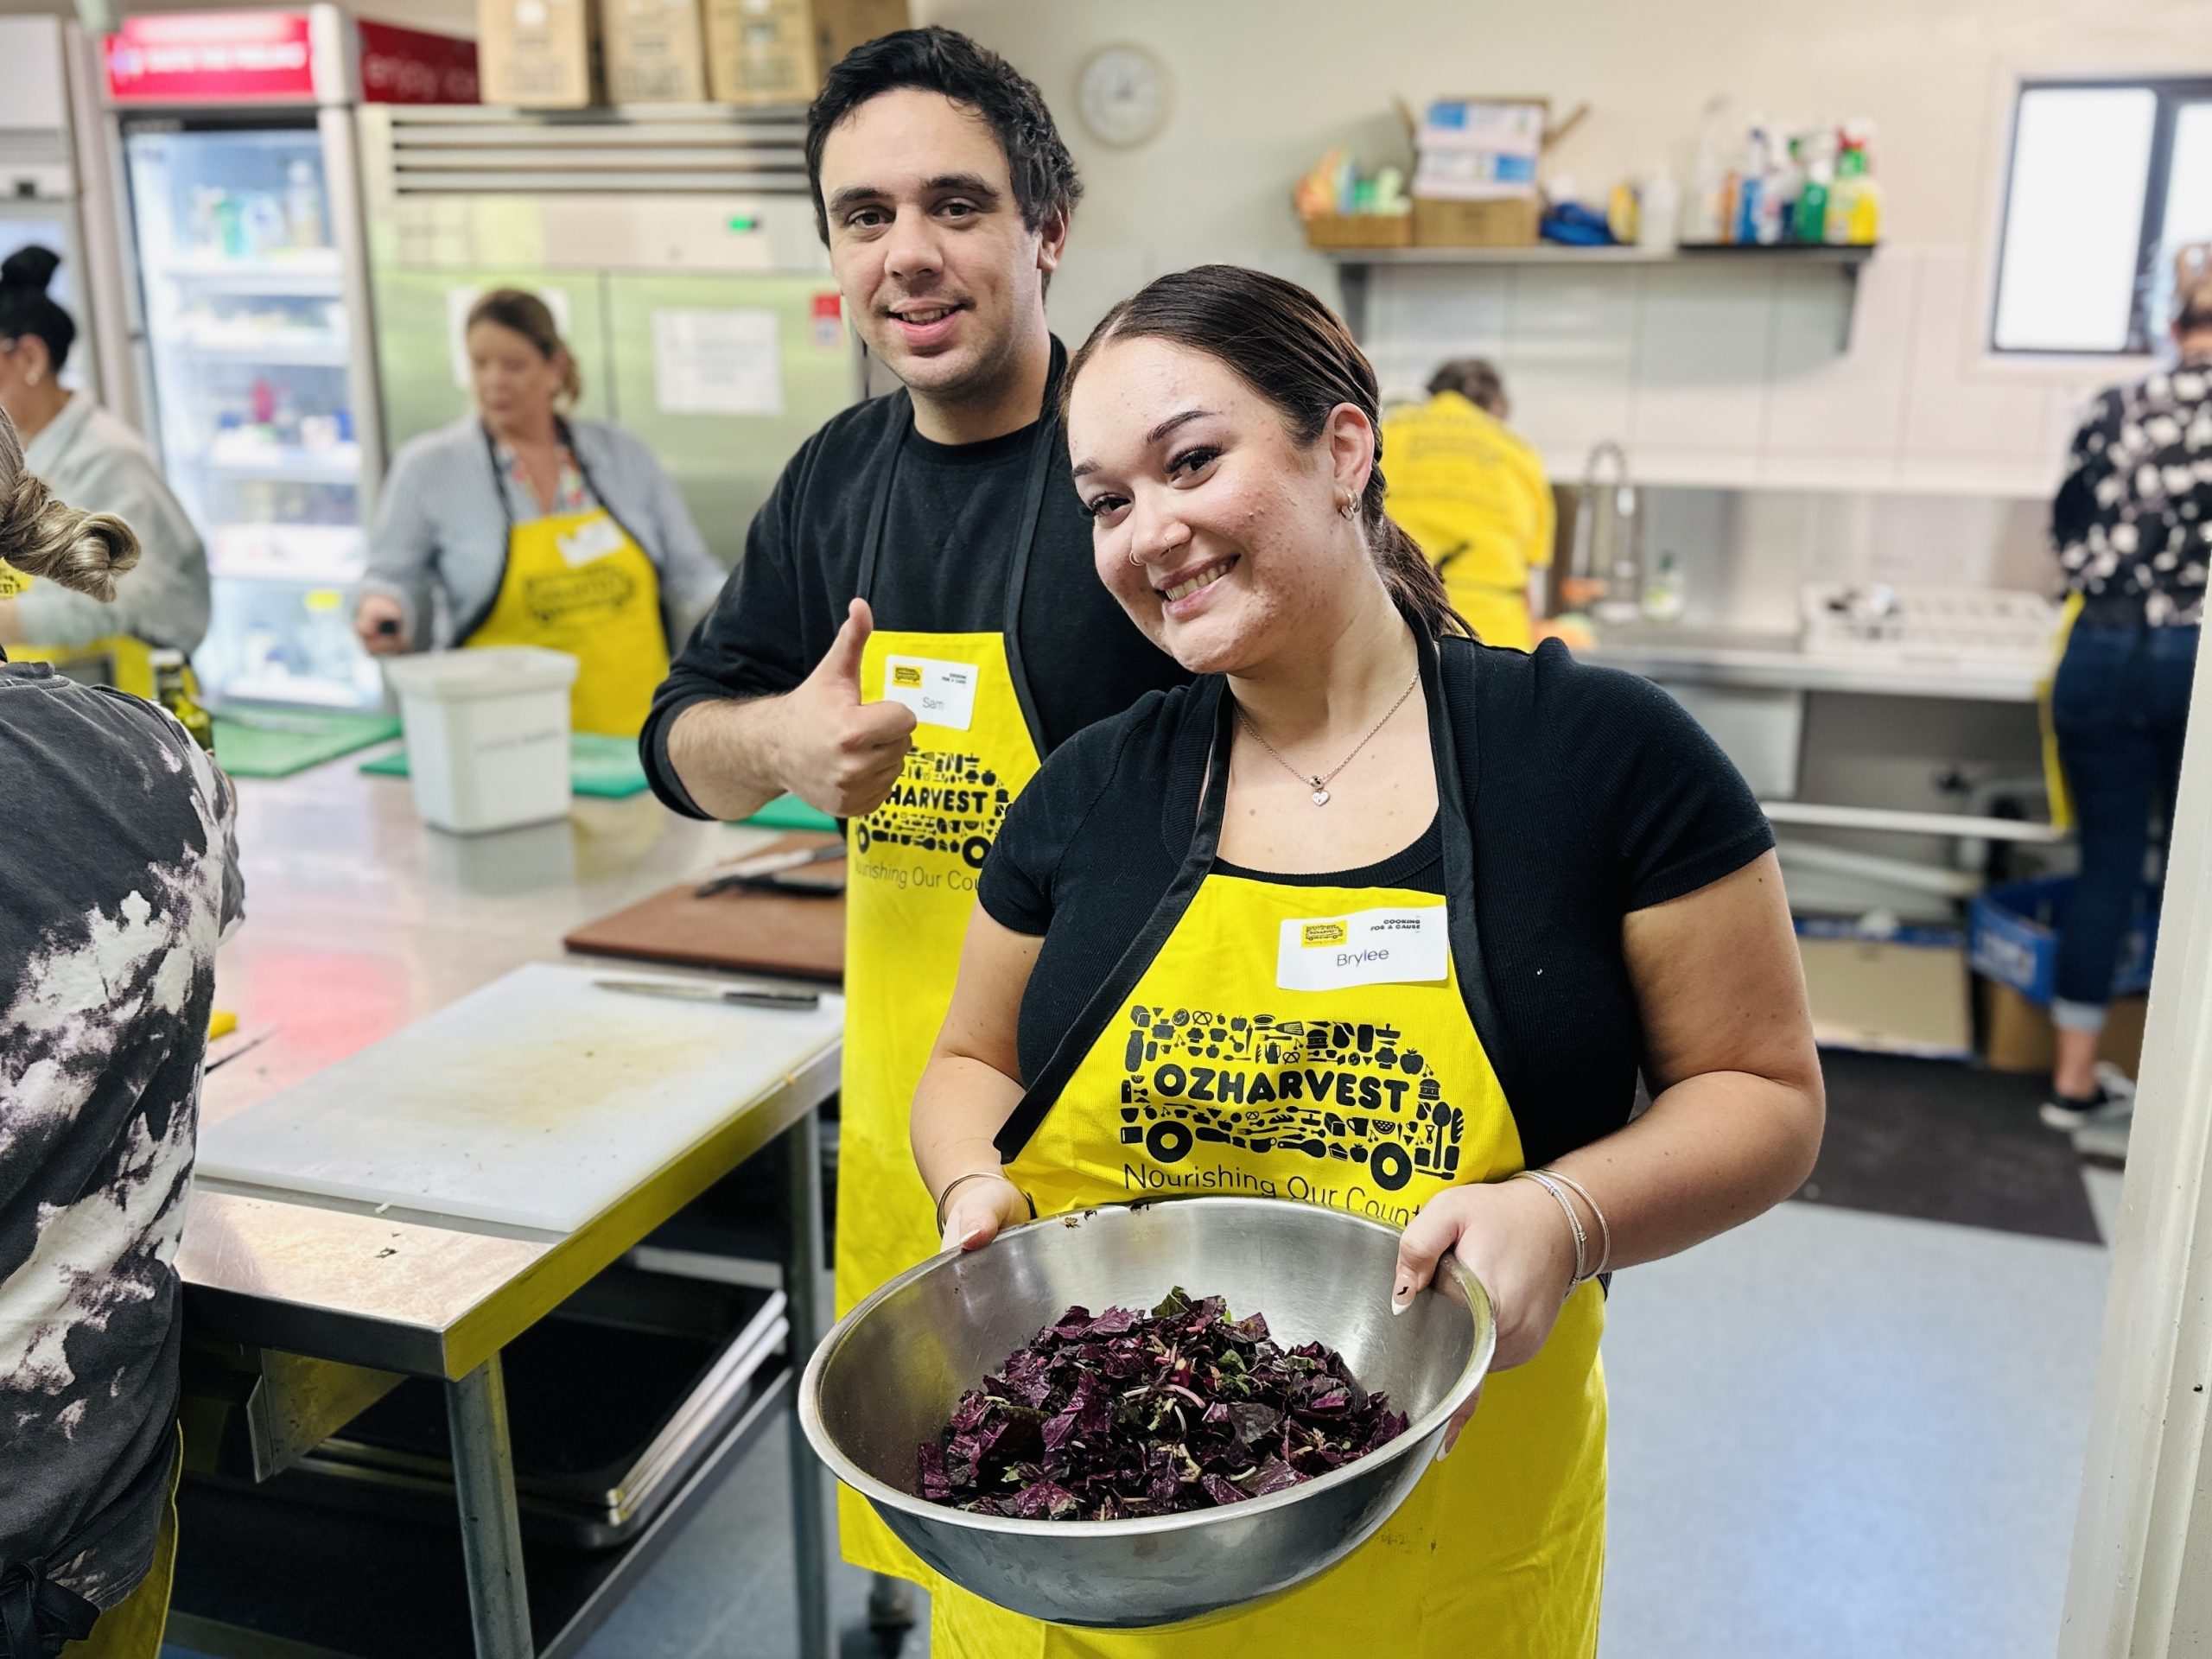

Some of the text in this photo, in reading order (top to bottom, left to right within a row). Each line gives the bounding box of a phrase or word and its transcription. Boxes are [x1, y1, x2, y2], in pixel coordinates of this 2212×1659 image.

[923, 696, 944, 710] Sam
[912, 866, 942, 887] Our
[947, 869, 978, 891] Co
[1337, 949, 1389, 967] Brylee
[1154, 1063, 1409, 1113] OZHARVEST
[1124, 1164, 1276, 1199] Nourishing
[1287, 1176, 1338, 1206] Our
